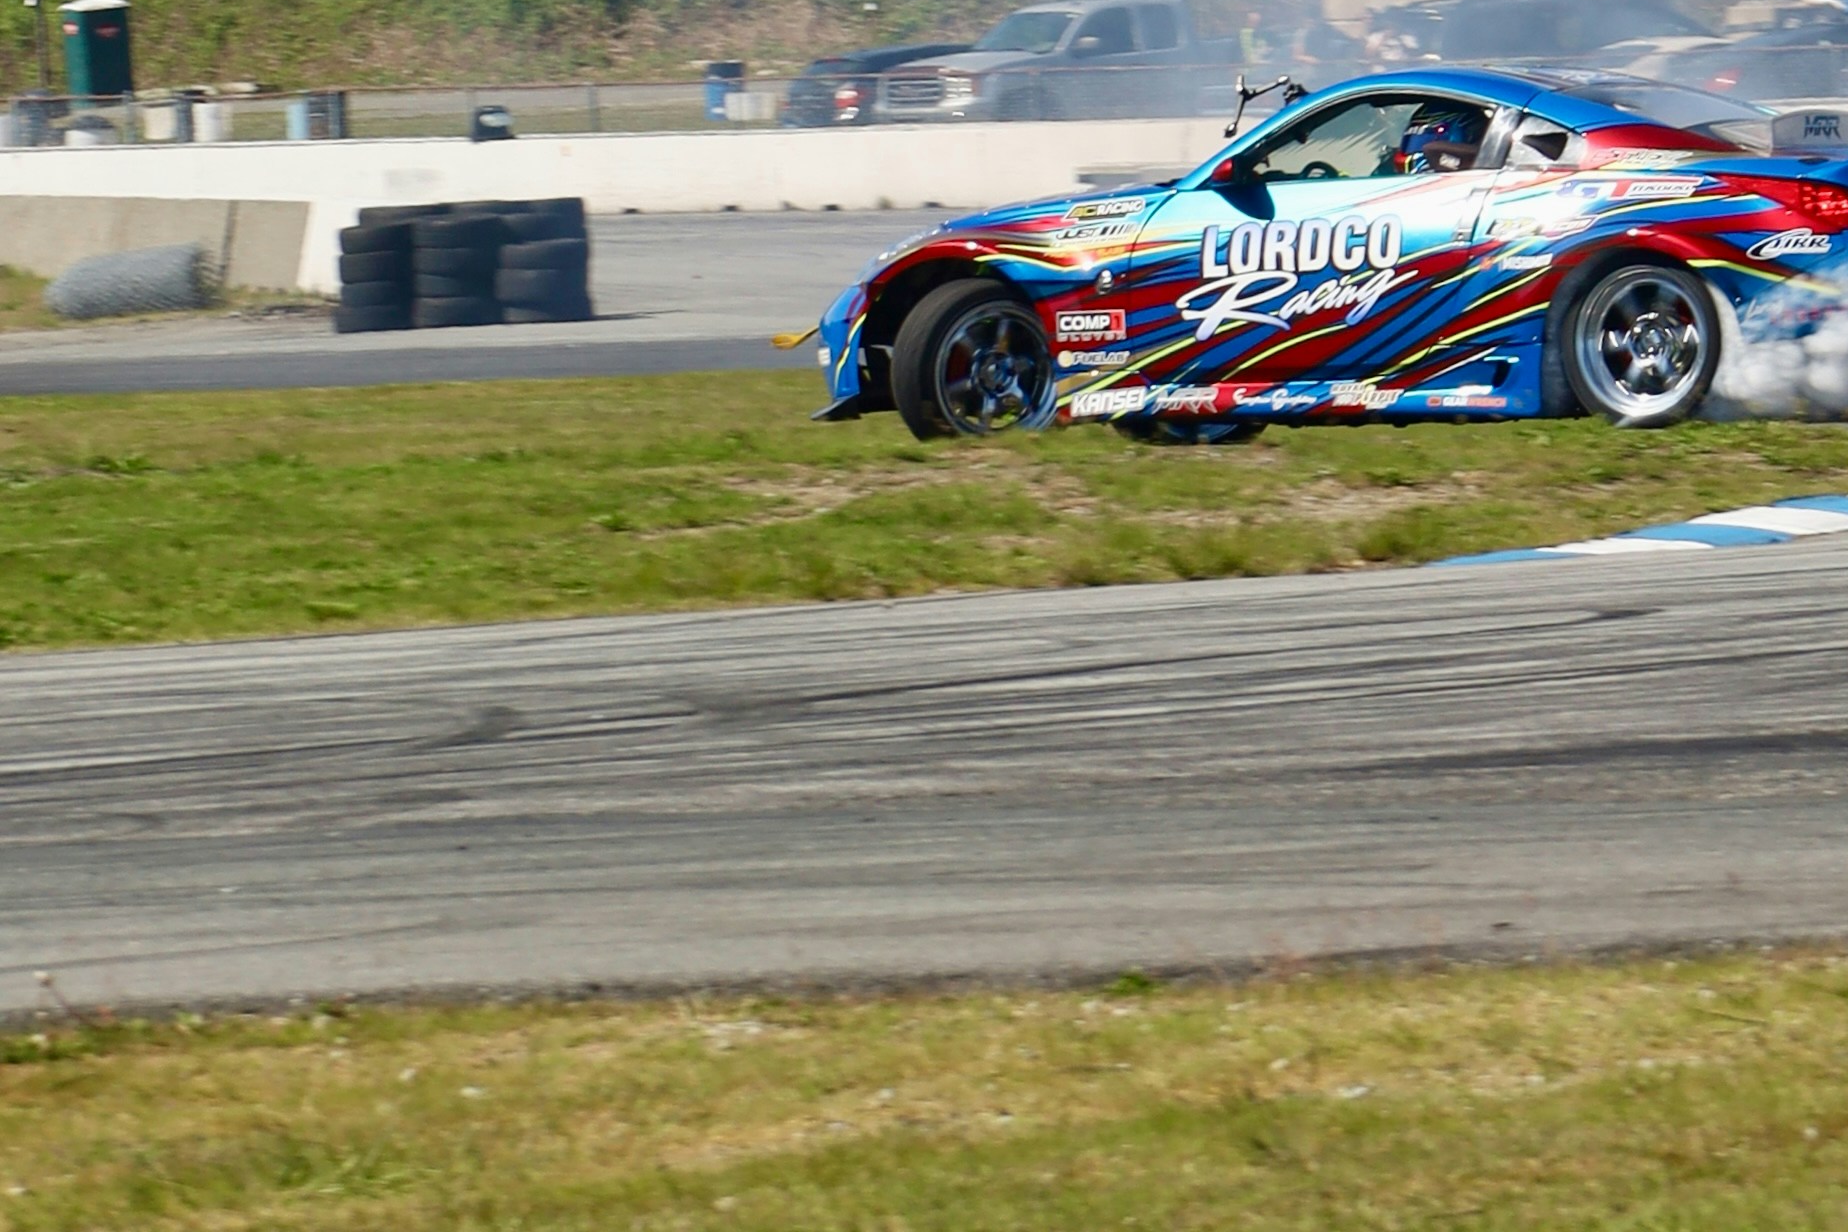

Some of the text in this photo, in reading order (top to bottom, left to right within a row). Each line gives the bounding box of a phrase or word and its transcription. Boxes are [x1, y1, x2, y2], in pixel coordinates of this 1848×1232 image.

[1202, 213, 1402, 278] LORDCO
[1175, 268, 1419, 341] Racing
[1070, 386, 1146, 417] KANSEI
